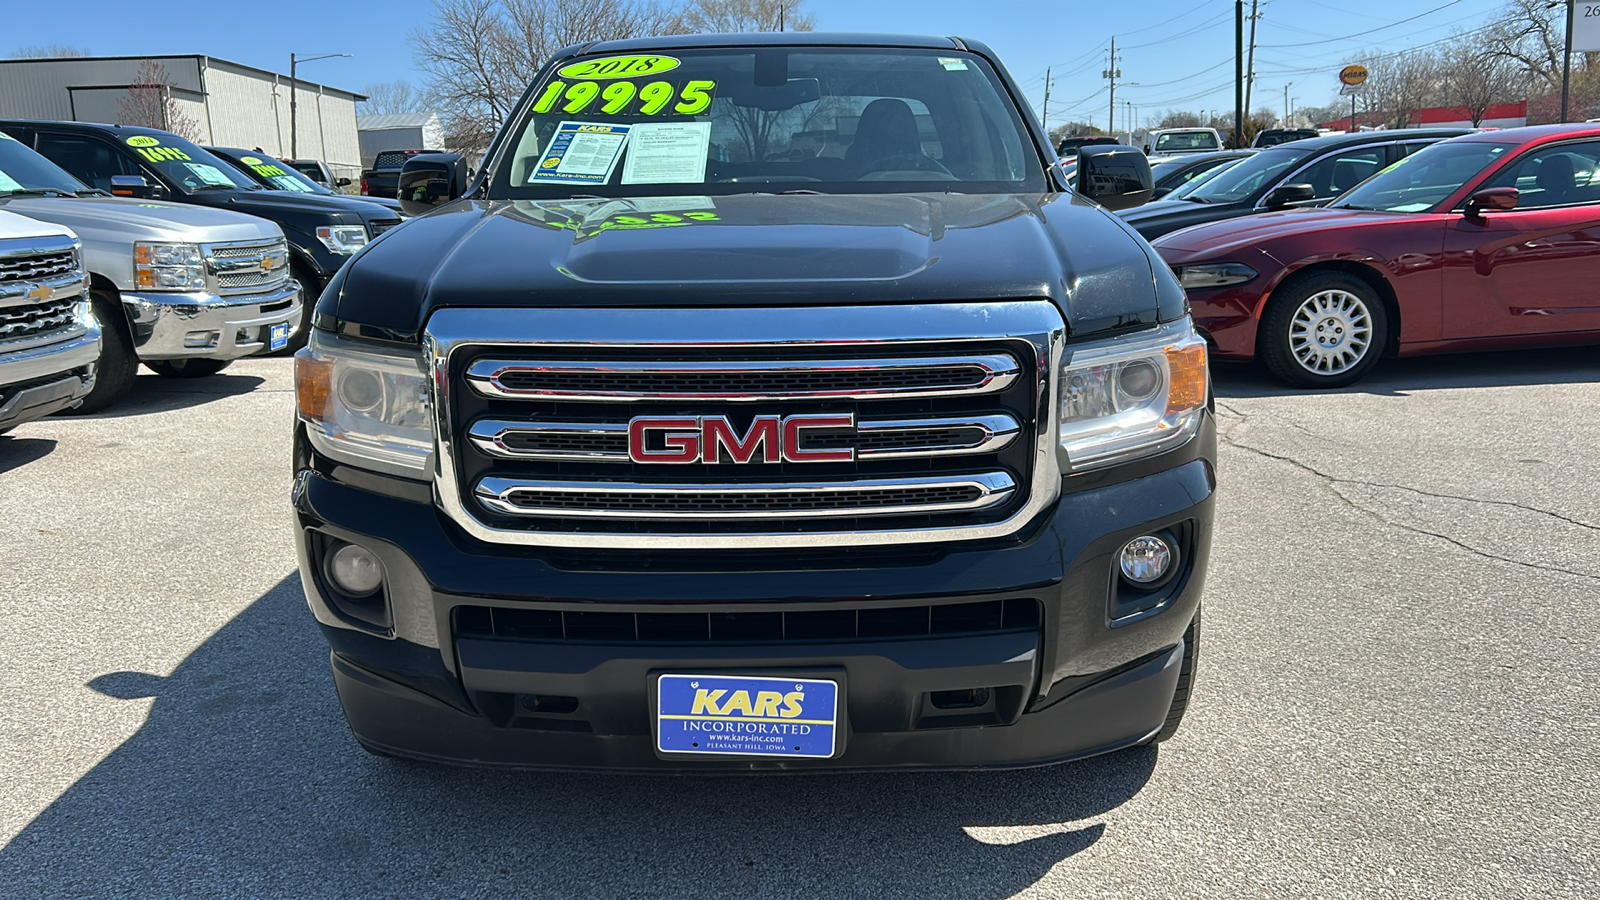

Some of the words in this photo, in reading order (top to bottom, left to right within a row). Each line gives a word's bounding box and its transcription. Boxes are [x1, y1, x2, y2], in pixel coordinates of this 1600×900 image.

[577, 57, 660, 76] 2018
[532, 80, 715, 115] 19995
[137, 147, 191, 162] 16995
[628, 412, 855, 464] GMC
[691, 689, 804, 718] KARS
[683, 721, 811, 735] INCORPORATED
[706, 742, 742, 750] PLEASANT
[709, 734, 784, 743] www.kars-inc.com
